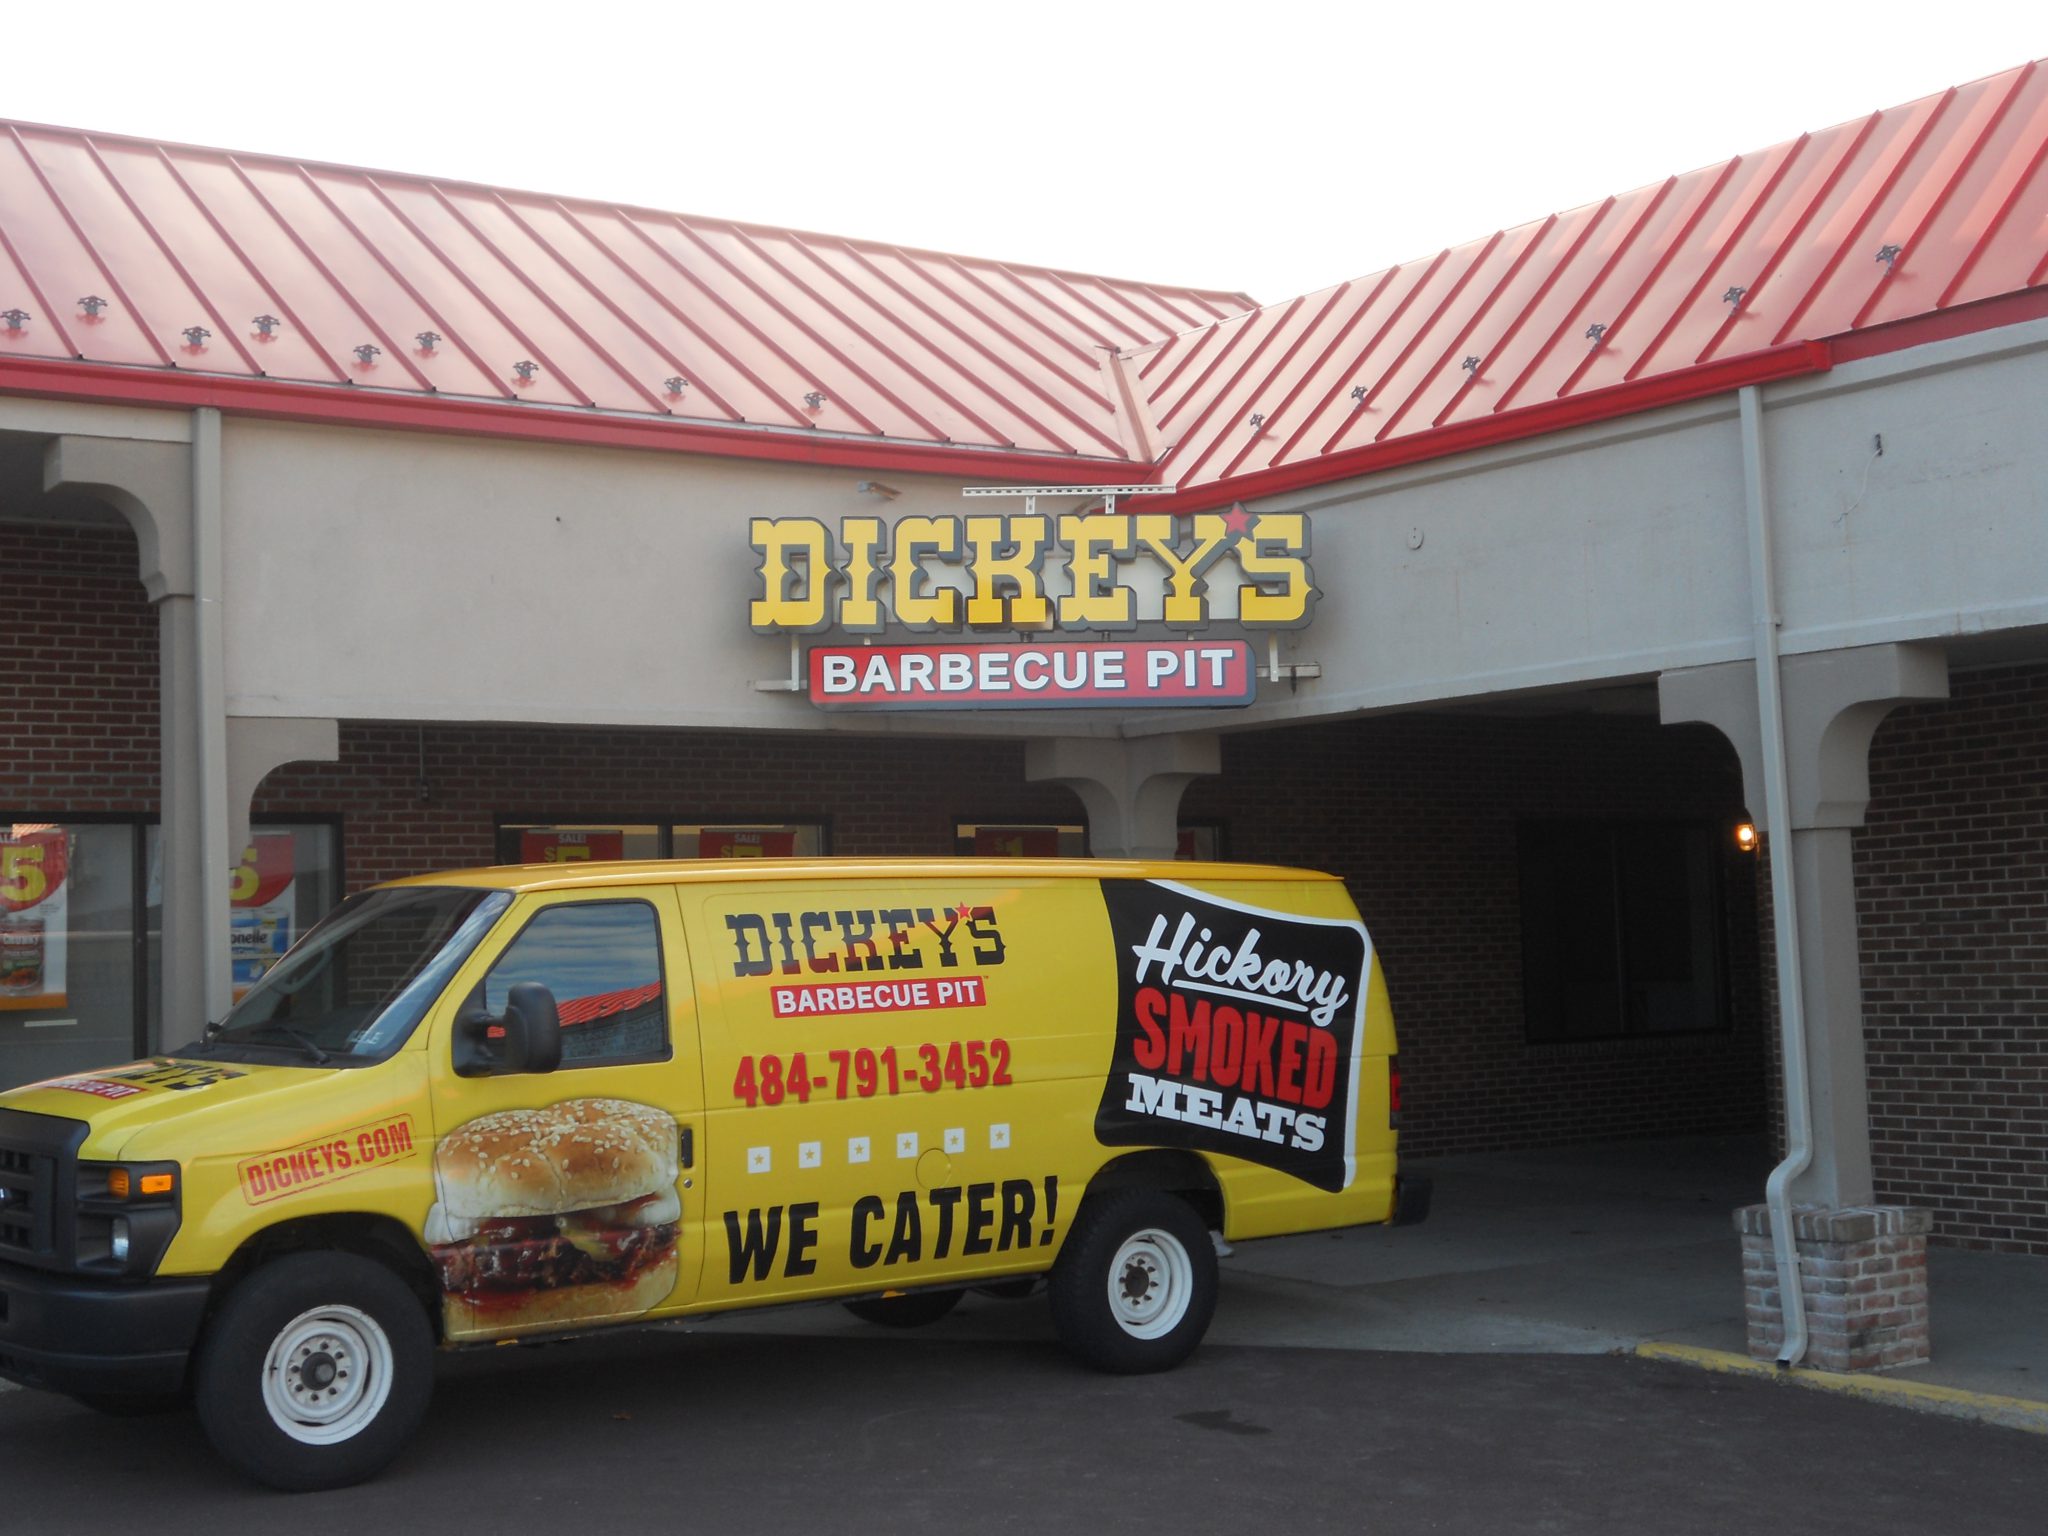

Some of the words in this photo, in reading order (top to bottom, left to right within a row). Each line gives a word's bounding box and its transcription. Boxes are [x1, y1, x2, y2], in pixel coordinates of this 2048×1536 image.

[749, 508, 1320, 632] DICKEY'S
[821, 650, 1126, 693] BARBECUE
[1146, 648, 1234, 688] PIT
[725, 904, 1006, 977] DICKEY'S
[1132, 912, 1350, 1027] Hickory
[775, 983, 928, 1014] BARBECUE
[938, 980, 979, 1005] PIT
[733, 1038, 1012, 1108] 484-791-3452
[1133, 987, 1338, 1110] SMOKED
[1125, 1073, 1327, 1152] MEATS
[723, 1202, 819, 1284] WE
[849, 1175, 1058, 1269] CATER!
